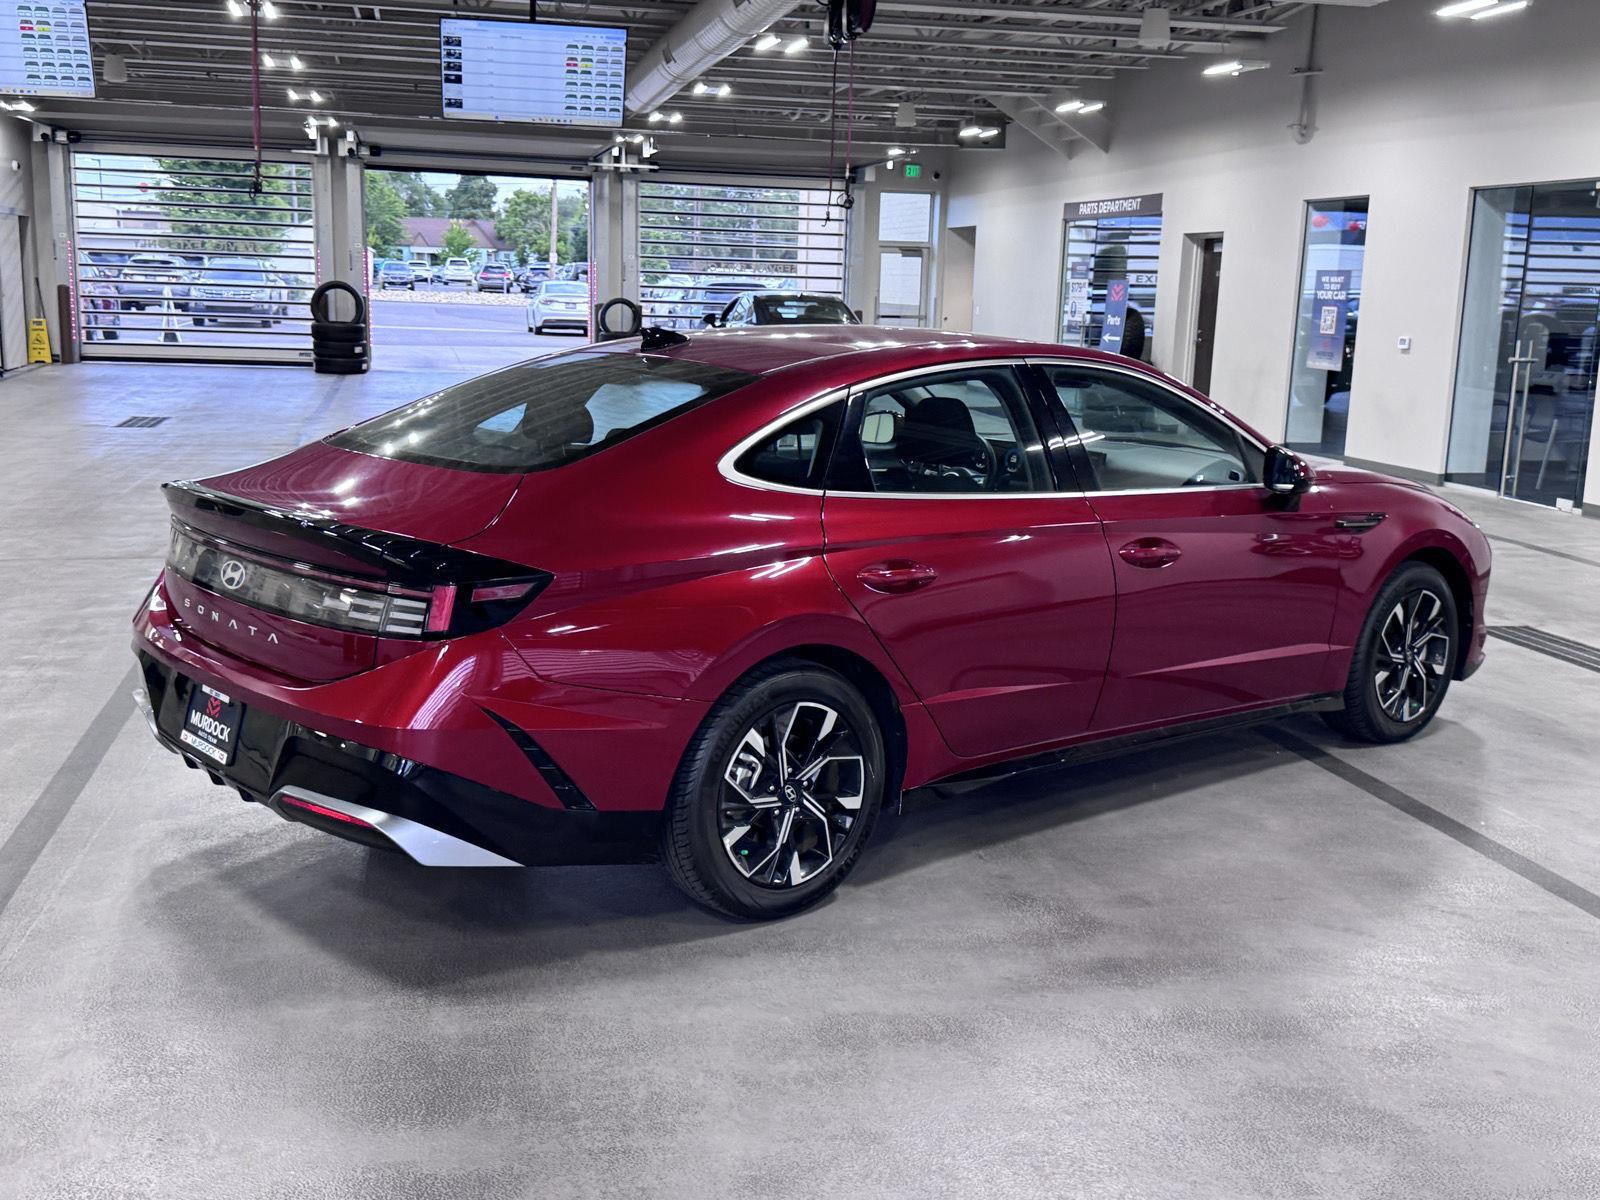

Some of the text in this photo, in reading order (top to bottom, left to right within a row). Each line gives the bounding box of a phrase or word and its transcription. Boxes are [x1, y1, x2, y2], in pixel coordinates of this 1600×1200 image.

[1079, 198, 1141, 215] PARTS DEPARTMENT
[1316, 290, 1346, 300] YOUR CAR
[1107, 314, 1121, 326] Parts
[184, 598, 279, 644] SONATA
[190, 709, 231, 742] MURDOCK
